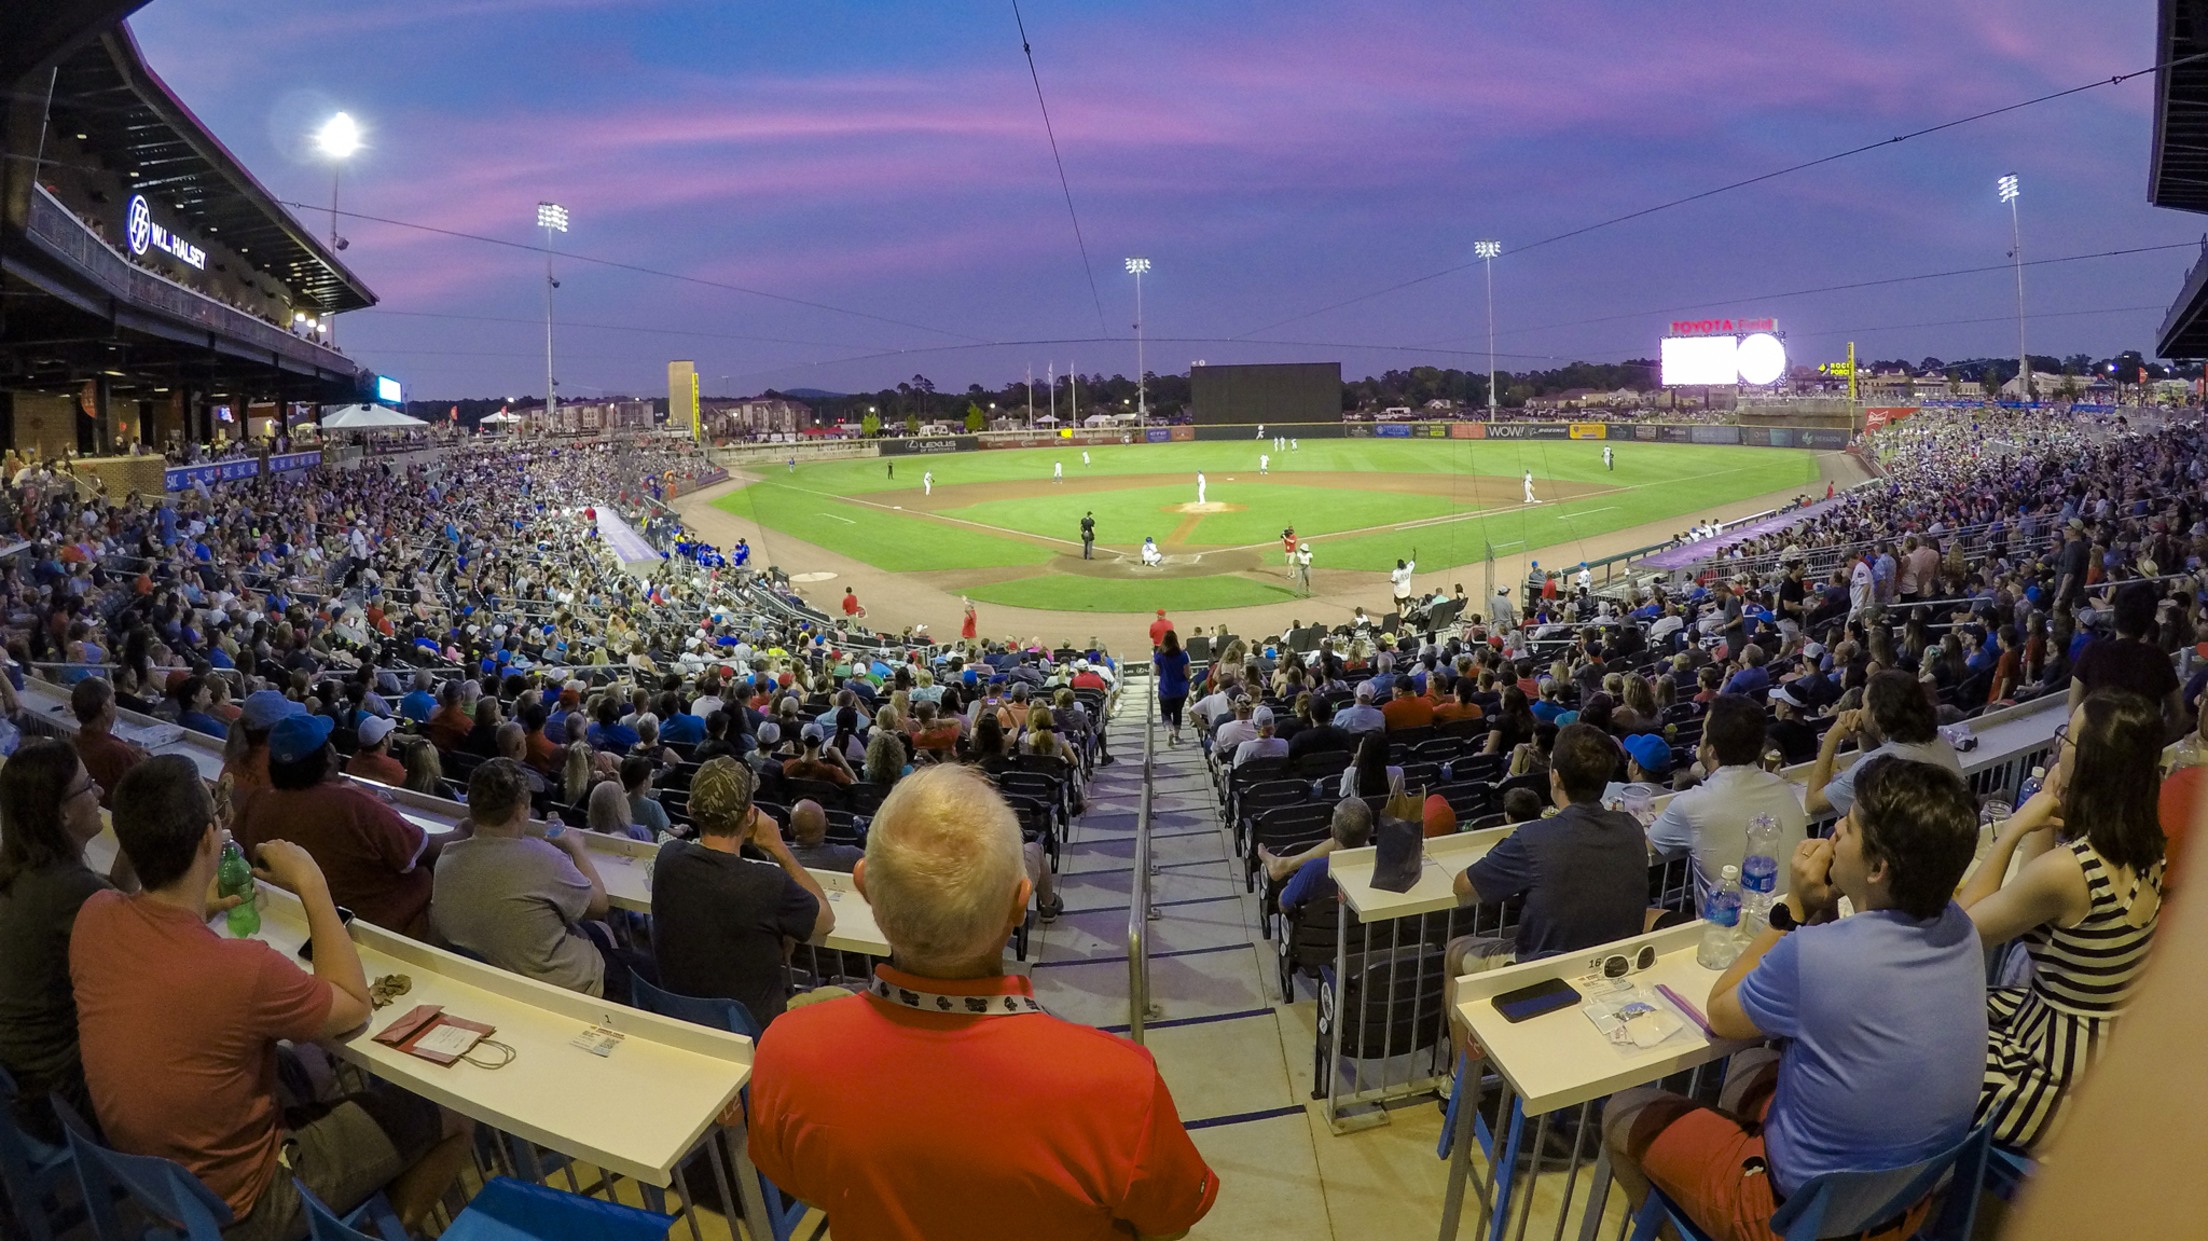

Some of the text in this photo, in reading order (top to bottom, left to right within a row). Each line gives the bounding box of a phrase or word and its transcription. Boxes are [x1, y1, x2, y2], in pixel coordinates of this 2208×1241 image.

[172, 233, 206, 271] HALSEY
[1672, 319, 1733, 335] TOYOTA
[1488, 425, 1525, 437] WOW!
[920, 440, 956, 448] LEXUS
[1588, 957, 1602, 968] 16
[604, 1013, 612, 1024] 1
